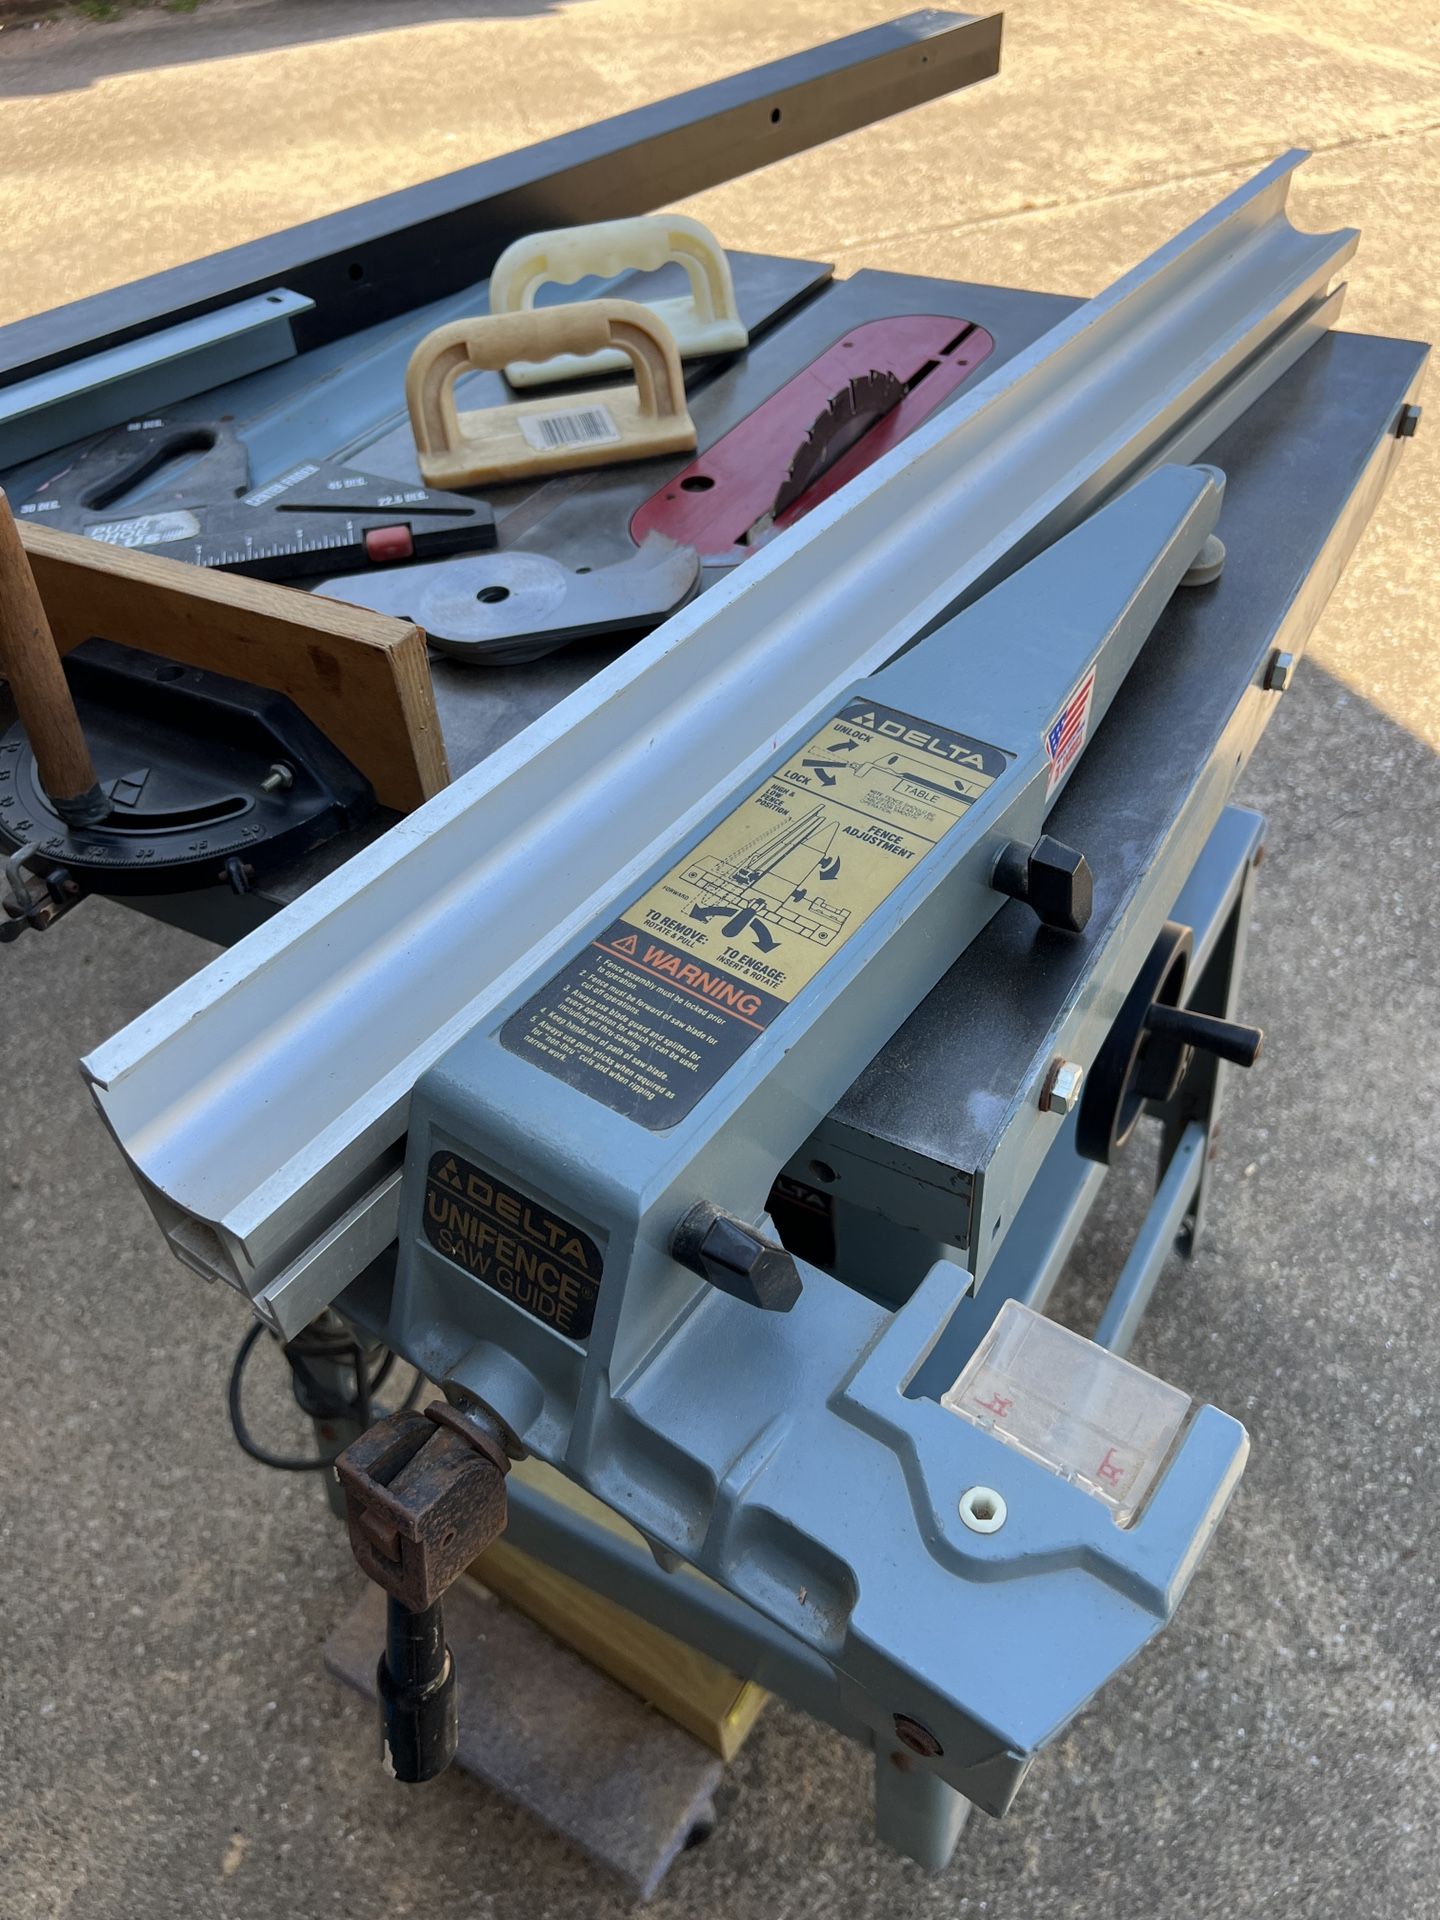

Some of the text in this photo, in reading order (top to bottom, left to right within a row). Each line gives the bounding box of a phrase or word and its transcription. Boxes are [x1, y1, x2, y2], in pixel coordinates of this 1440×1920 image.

[92, 521, 150, 536] PUSH
[833, 723, 874, 743] UNLOCK
[878, 720, 984, 770] DELTA
[765, 788, 783, 798] LOW
[770, 784, 789, 794] HIGH
[783, 770, 812, 785] LOCK
[904, 784, 940, 803] TABLE
[755, 798, 790, 815] POSITION
[760, 793, 785, 806] FENCE
[842, 826, 915, 859] ADJUSTMENT
[867, 825, 904, 844] FENCE
[662, 885, 690, 901] FORWARD
[643, 919, 671, 937] ROTATE
[677, 936, 695, 948] PULL
[645, 909, 709, 945] TO REMOVE:
[596, 965, 607, 974] to
[642, 945, 762, 1016] WARNING
[716, 955, 744, 972] INSERT
[750, 973, 780, 989] ROTATE
[722, 946, 787, 984] TO ENGAGE:
[586, 973, 610, 988] Fence
[607, 984, 627, 997] must
[624, 993, 637, 1003] be
[634, 998, 664, 1016] forward
[660, 1012, 673, 1021] of
[669, 1017, 686, 1028] saw
[684, 1024, 708, 1039] blade
[704, 1035, 719, 1045] for
[602, 958, 625, 973] Fence
[622, 969, 657, 990] assembly
[655, 985, 675, 999] must
[672, 995, 685, 1004] be
[682, 1000, 708, 1016] locked
[705, 1012, 726, 1027] prior
[555, 1002, 591, 1024] including
[588, 1019, 601, 1028] all
[562, 996, 584, 1010] every
[581, 1005, 618, 1027] operation
[615, 1022, 630, 1033] for
[625, 1028, 650, 1044] which
[653, 1044, 670, 1055] can
[667, 1050, 681, 1061] be
[569, 988, 598, 1006] Always
[594, 1002, 610, 1012] use
[607, 1008, 630, 1022] blade
[626, 1018, 652, 1035] guard
[648, 1029, 665, 1041] and
[661, 1037, 691, 1055] splitter
[688, 1050, 702, 1061] for
[522, 1034, 550, 1051] narrow
[546, 1010, 568, 1025] Keep
[564, 1020, 589, 1035] hands
[585, 1031, 601, 1042] out
[598, 1037, 610, 1047] of
[605, 1042, 626, 1056] path
[622, 1051, 634, 1060] of
[630, 1057, 648, 1069] saw
[530, 1026, 543, 1036] for
[577, 1053, 596, 1065] cuts
[592, 1061, 610, 1073] and
[606, 1069, 631, 1084] when
[625, 1080, 657, 1101] ripping
[536, 1019, 564, 1037] Always
[561, 1034, 577, 1044] use
[573, 1040, 595, 1055] push
[591, 1050, 616, 1065] sticks
[612, 1061, 636, 1076] when
[631, 1072, 667, 1094] required
[664, 1090, 676, 1099] as
[466, 1173, 589, 1269] DELTA
[438, 1228, 574, 1330] SAW GUIDE
